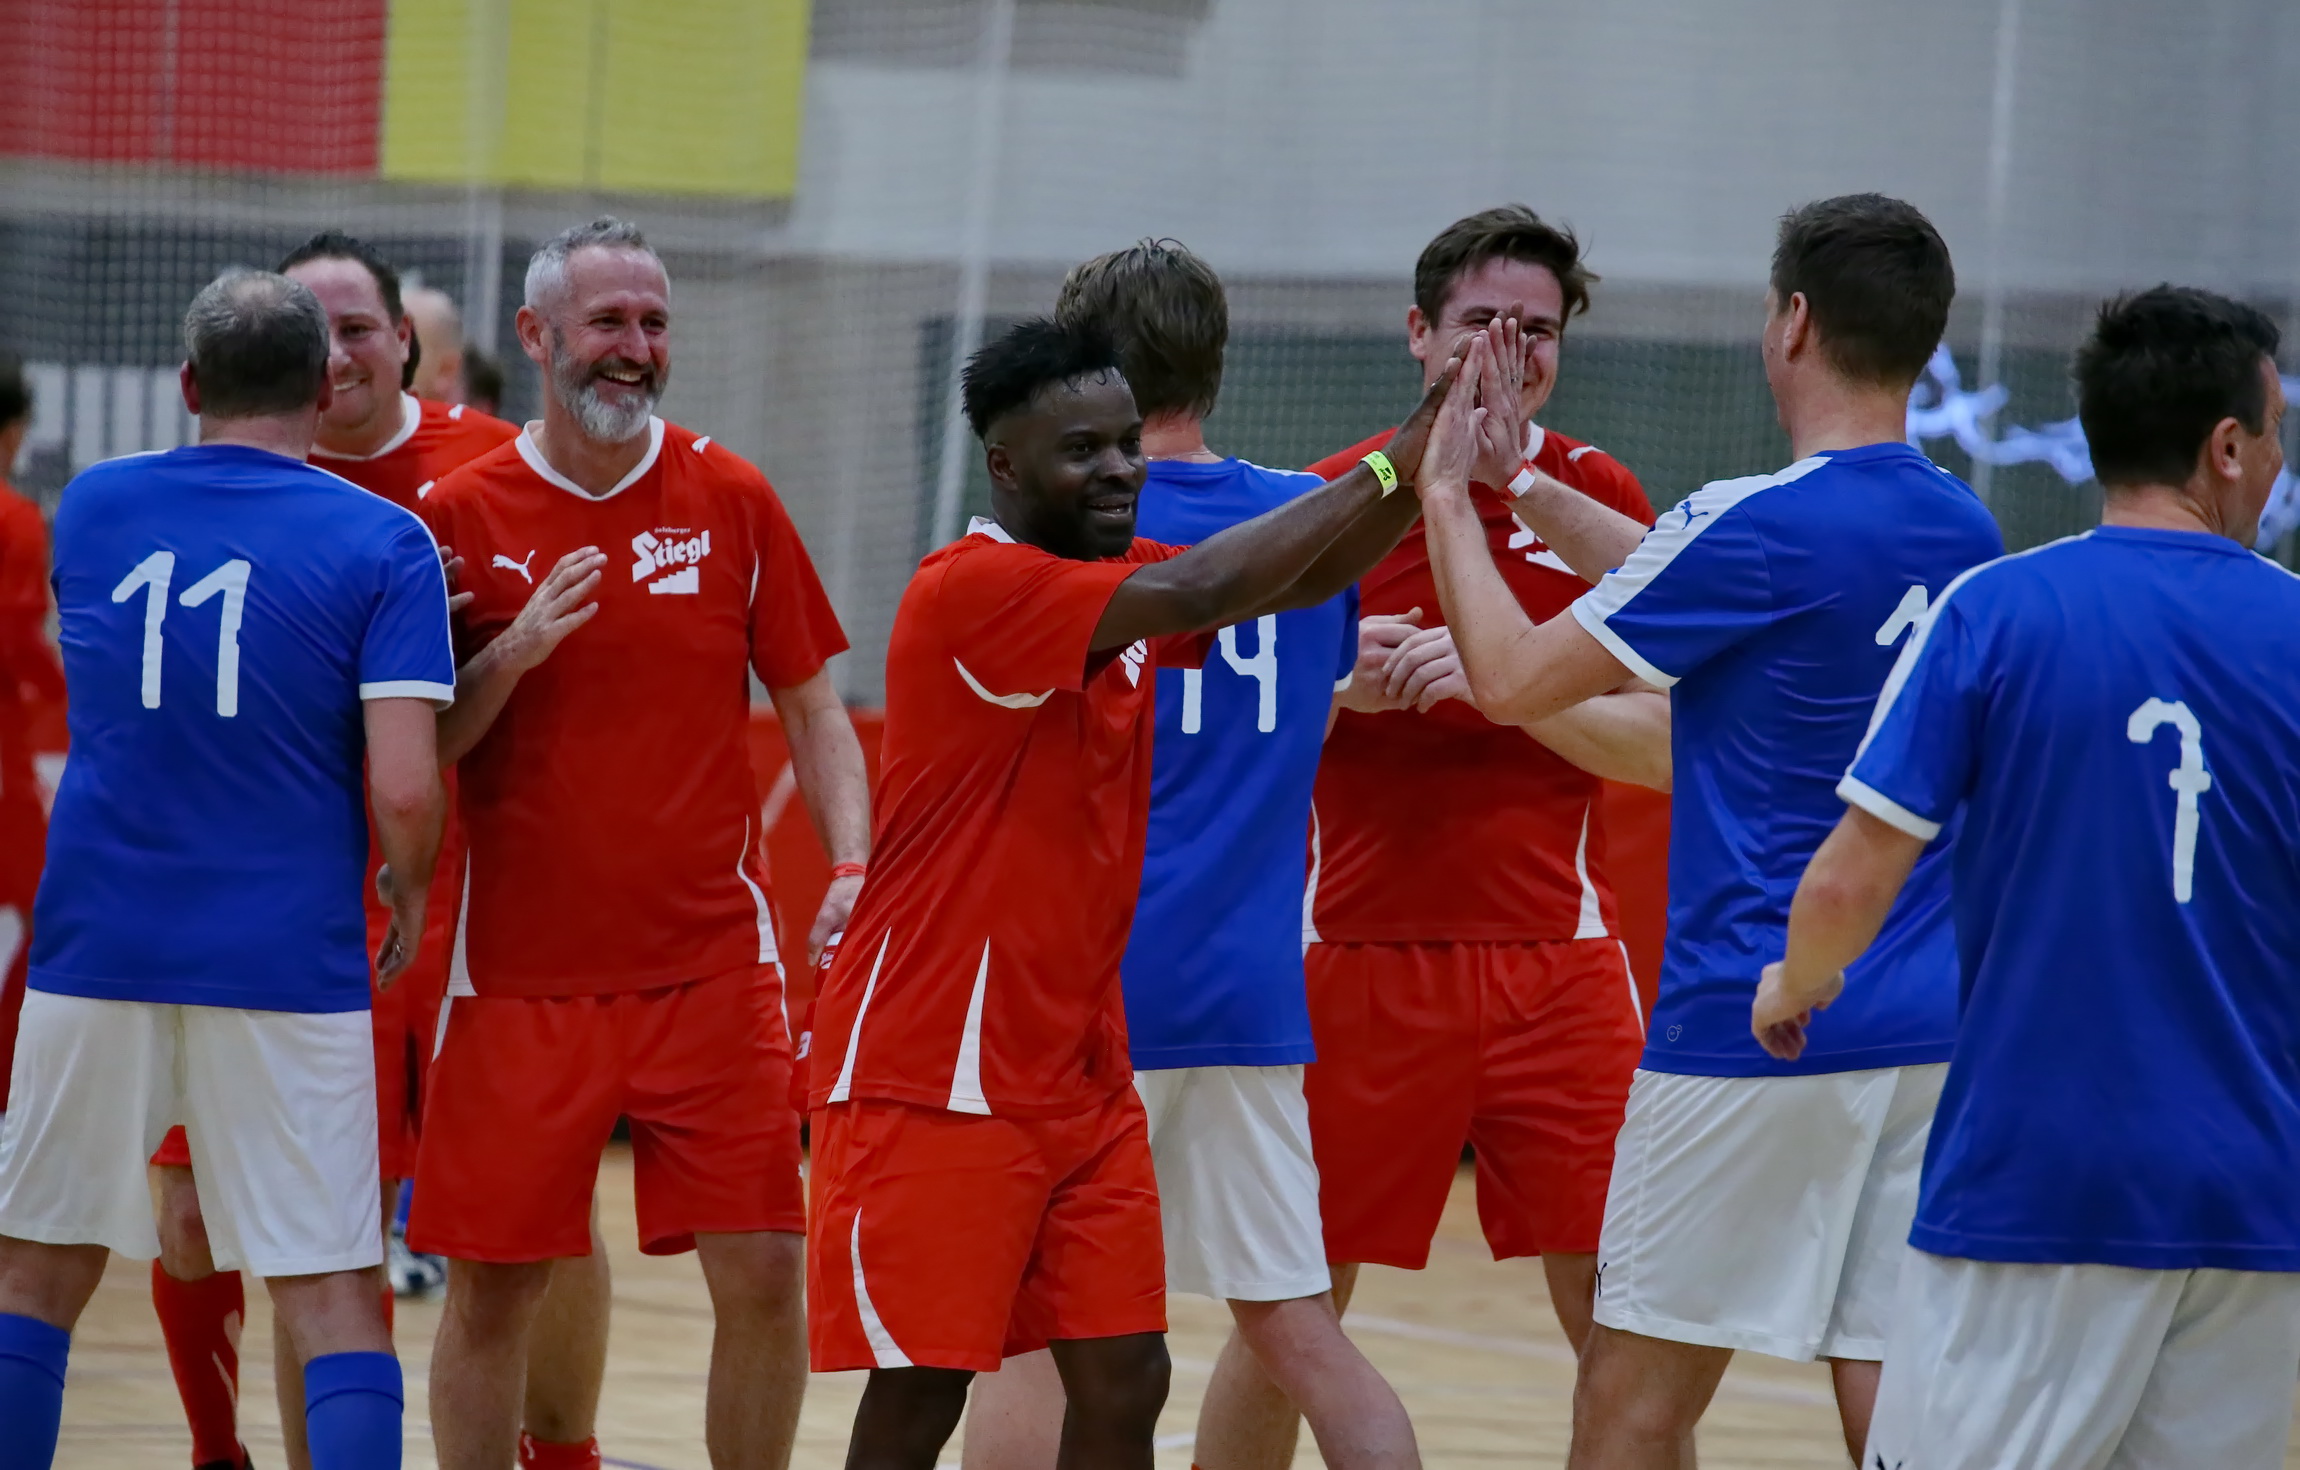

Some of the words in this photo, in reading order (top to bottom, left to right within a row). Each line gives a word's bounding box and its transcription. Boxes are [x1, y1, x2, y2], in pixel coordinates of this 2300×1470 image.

[112, 551, 251, 717] 11
[631, 529, 711, 583] Stiegl
[2127, 697, 2211, 903] 7
